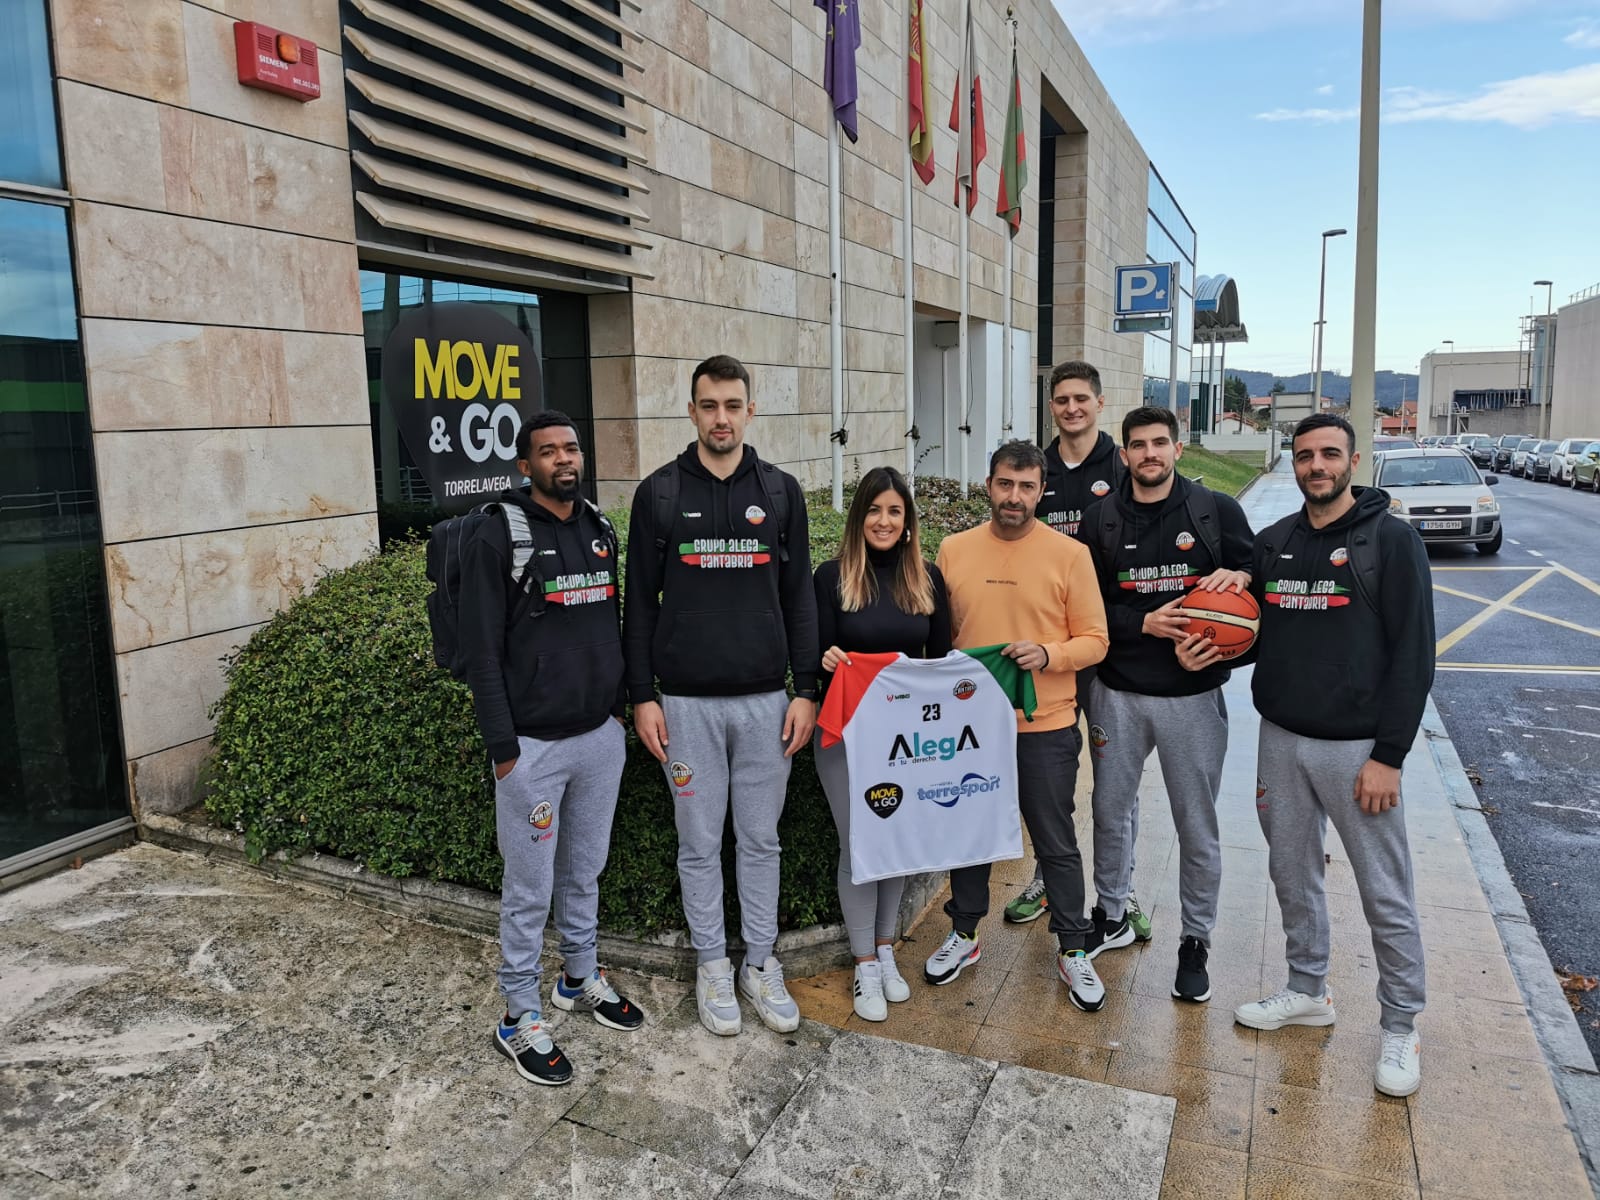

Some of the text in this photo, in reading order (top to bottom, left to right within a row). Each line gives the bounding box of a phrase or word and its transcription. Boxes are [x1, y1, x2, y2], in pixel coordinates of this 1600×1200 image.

[1120, 269, 1158, 310] P
[414, 337, 521, 400] MOVE
[428, 402, 522, 463] & GO
[444, 475, 512, 497] TORRELAVEGA
[693, 538, 726, 553] GRUPO
[1276, 579, 1308, 594] GRUPO
[922, 703, 941, 722] 23
[911, 755, 937, 764] derecho
[870, 786, 898, 800] MOVE
[917, 775, 1001, 801] torresport
[880, 796, 898, 808] GO
